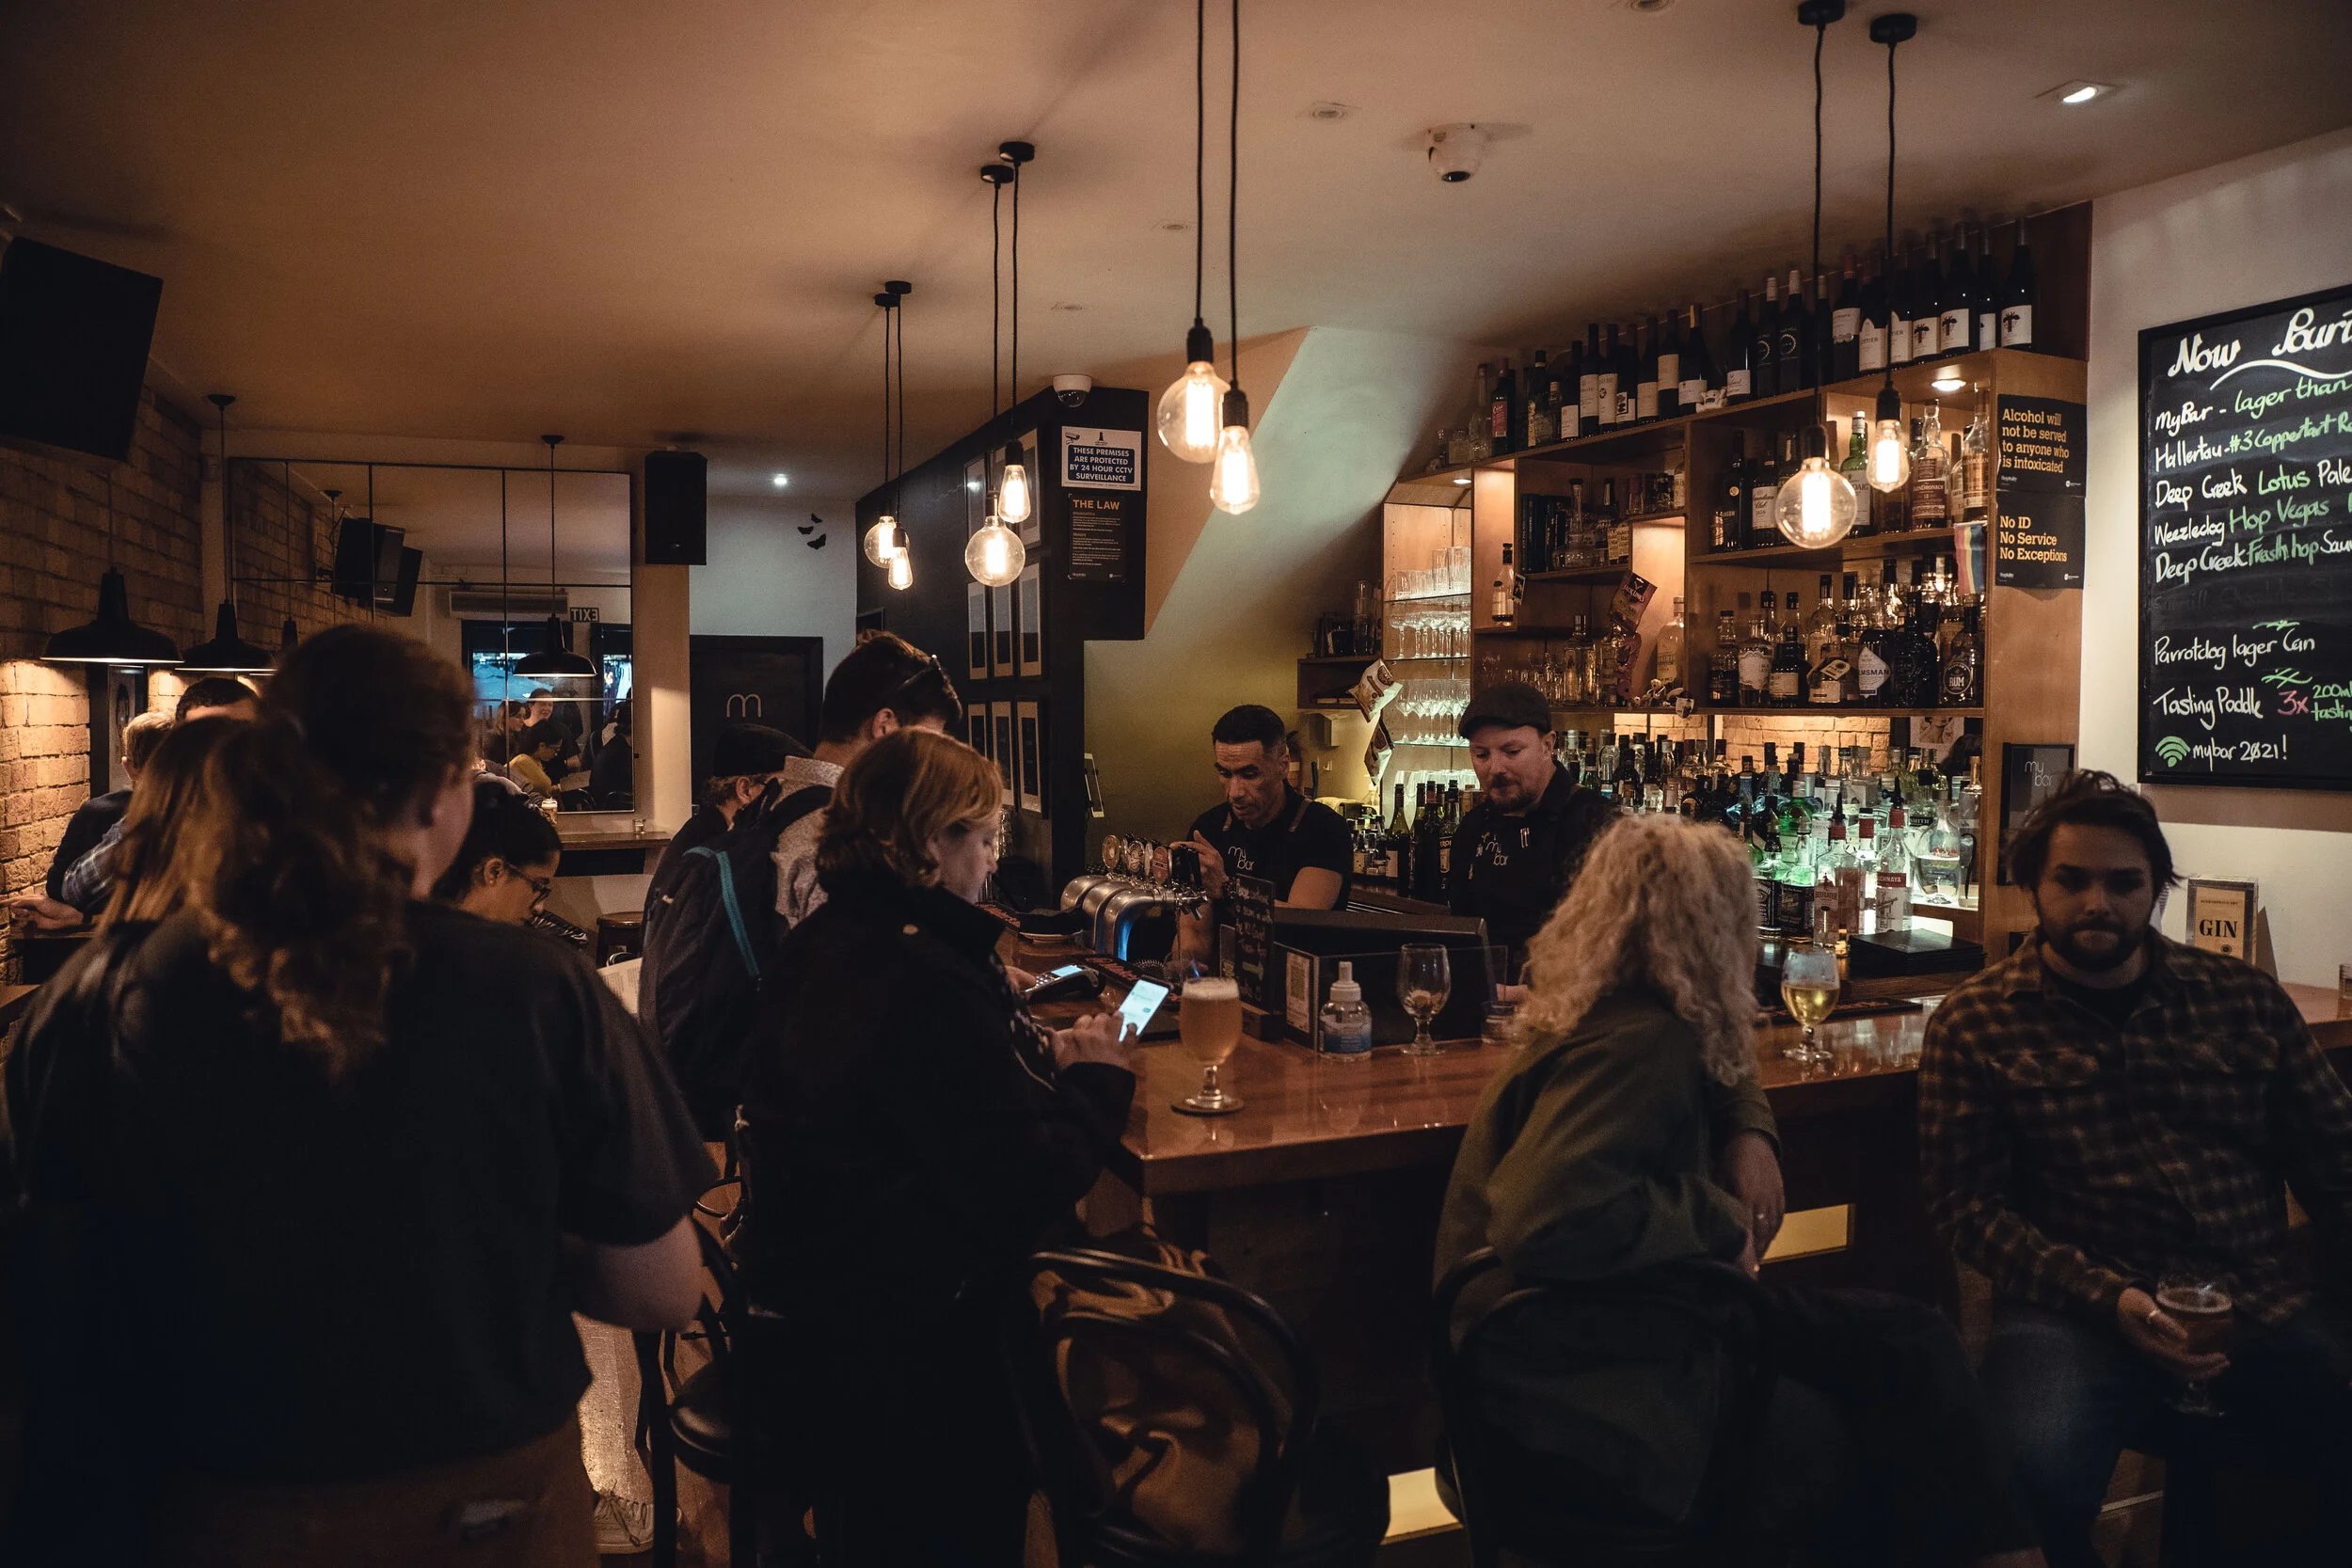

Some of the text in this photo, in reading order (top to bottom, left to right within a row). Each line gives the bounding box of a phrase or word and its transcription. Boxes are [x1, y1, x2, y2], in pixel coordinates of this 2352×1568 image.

[2167, 332, 2242, 377] Now
[2234, 389, 2292, 420] lager
[2295, 375, 2352, 400] than
[2001, 408, 2061, 426] Alcohol will
[2001, 425, 2067, 444] not be served
[1073, 447, 1130, 457] THESE PREMISES
[2001, 439, 2070, 460] to anyone who
[2154, 436, 2223, 473] Hallertau
[1081, 464, 1089, 472] 24
[1092, 465, 1113, 473] HOUR
[1115, 466, 1133, 474] CCTV
[1089, 457, 1128, 466] PROTECTED
[2001, 455, 2064, 474] is intoxicated
[1075, 472, 1127, 483] SURVEILLANCE
[2154, 480, 2193, 512] Deep
[2201, 467, 2249, 499] Creek
[2257, 464, 2311, 496] Lotus
[1073, 499, 1120, 511] THE LAW
[1999, 515, 2032, 530] No ID
[2154, 515, 2225, 547] Weezledog
[2229, 505, 2271, 534] Hop
[2277, 496, 2330, 528] Vegas
[1999, 531, 2058, 546] No Service
[1999, 546, 2068, 563] No Exceptions
[2155, 551, 2198, 586] Deep
[2199, 542, 2249, 572] Creek
[2247, 533, 2288, 566] Fresh
[2291, 532, 2320, 566] hop
[2154, 627, 2316, 671] Parrotdog lager Can
[1948, 676, 1965, 687] RUM
[725, 692, 762, 718] m
[2153, 686, 2216, 731] Tasting
[2192, 736, 2237, 772] mybar
[2025, 761, 2044, 777] my
[2034, 773, 2054, 787] bar
[1227, 846, 1247, 863] my
[1486, 841, 1502, 855] my
[1236, 857, 1256, 871] bar
[2200, 919, 2238, 939] GIN
